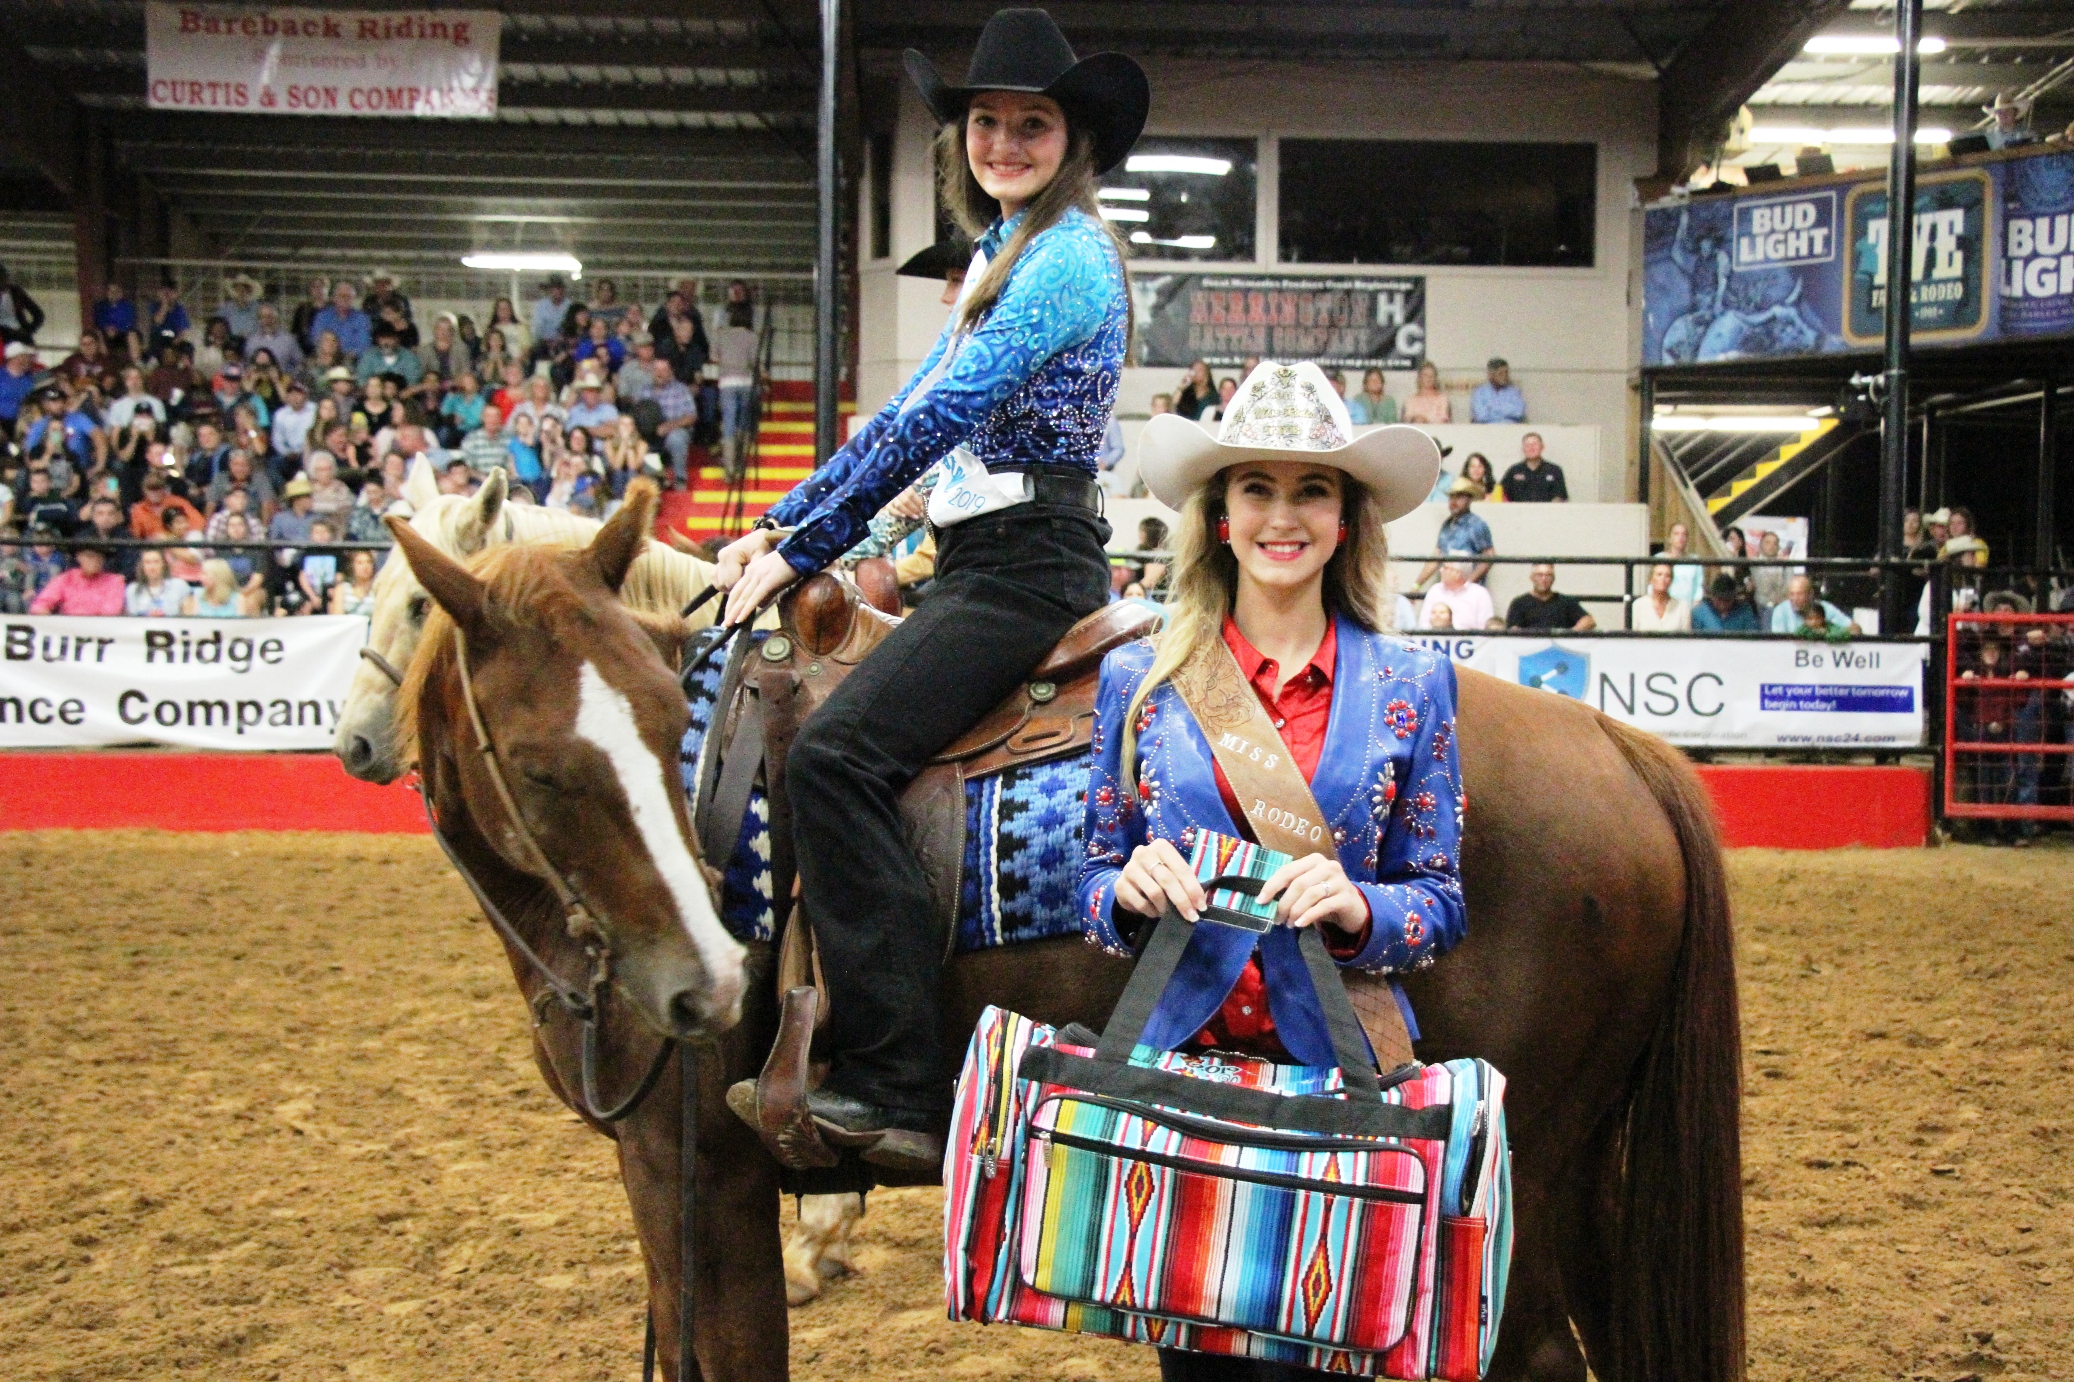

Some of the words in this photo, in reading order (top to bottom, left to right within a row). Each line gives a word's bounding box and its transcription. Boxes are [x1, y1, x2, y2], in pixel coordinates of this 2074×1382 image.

[178, 10, 341, 38] Bareback
[356, 17, 470, 46] Riding
[151, 79, 249, 106] CURTIS
[259, 85, 277, 107] &
[287, 84, 338, 109] SON
[1752, 202, 1816, 235] BUD
[2008, 212, 2074, 257] BU
[1740, 227, 1828, 262] LIGHT
[1920, 280, 1963, 302] RODEO
[1377, 292, 1403, 325] H
[1396, 322, 1423, 355] C
[947, 487, 985, 514] 2019
[5, 625, 114, 662] Burr
[145, 630, 284, 673] Ridge
[1795, 650, 1823, 667] Be
[1832, 651, 1880, 669] Well
[1599, 672, 1724, 717] NSC
[1764, 686, 1783, 695] Let
[1786, 687, 1812, 697] your
[1815, 686, 1850, 697] better
[1852, 687, 1909, 697] tomorrow
[1764, 700, 1797, 711] begin
[118, 689, 346, 734] Company
[1217, 732, 1279, 769] MISS
[1250, 799, 1322, 841] RODEO
